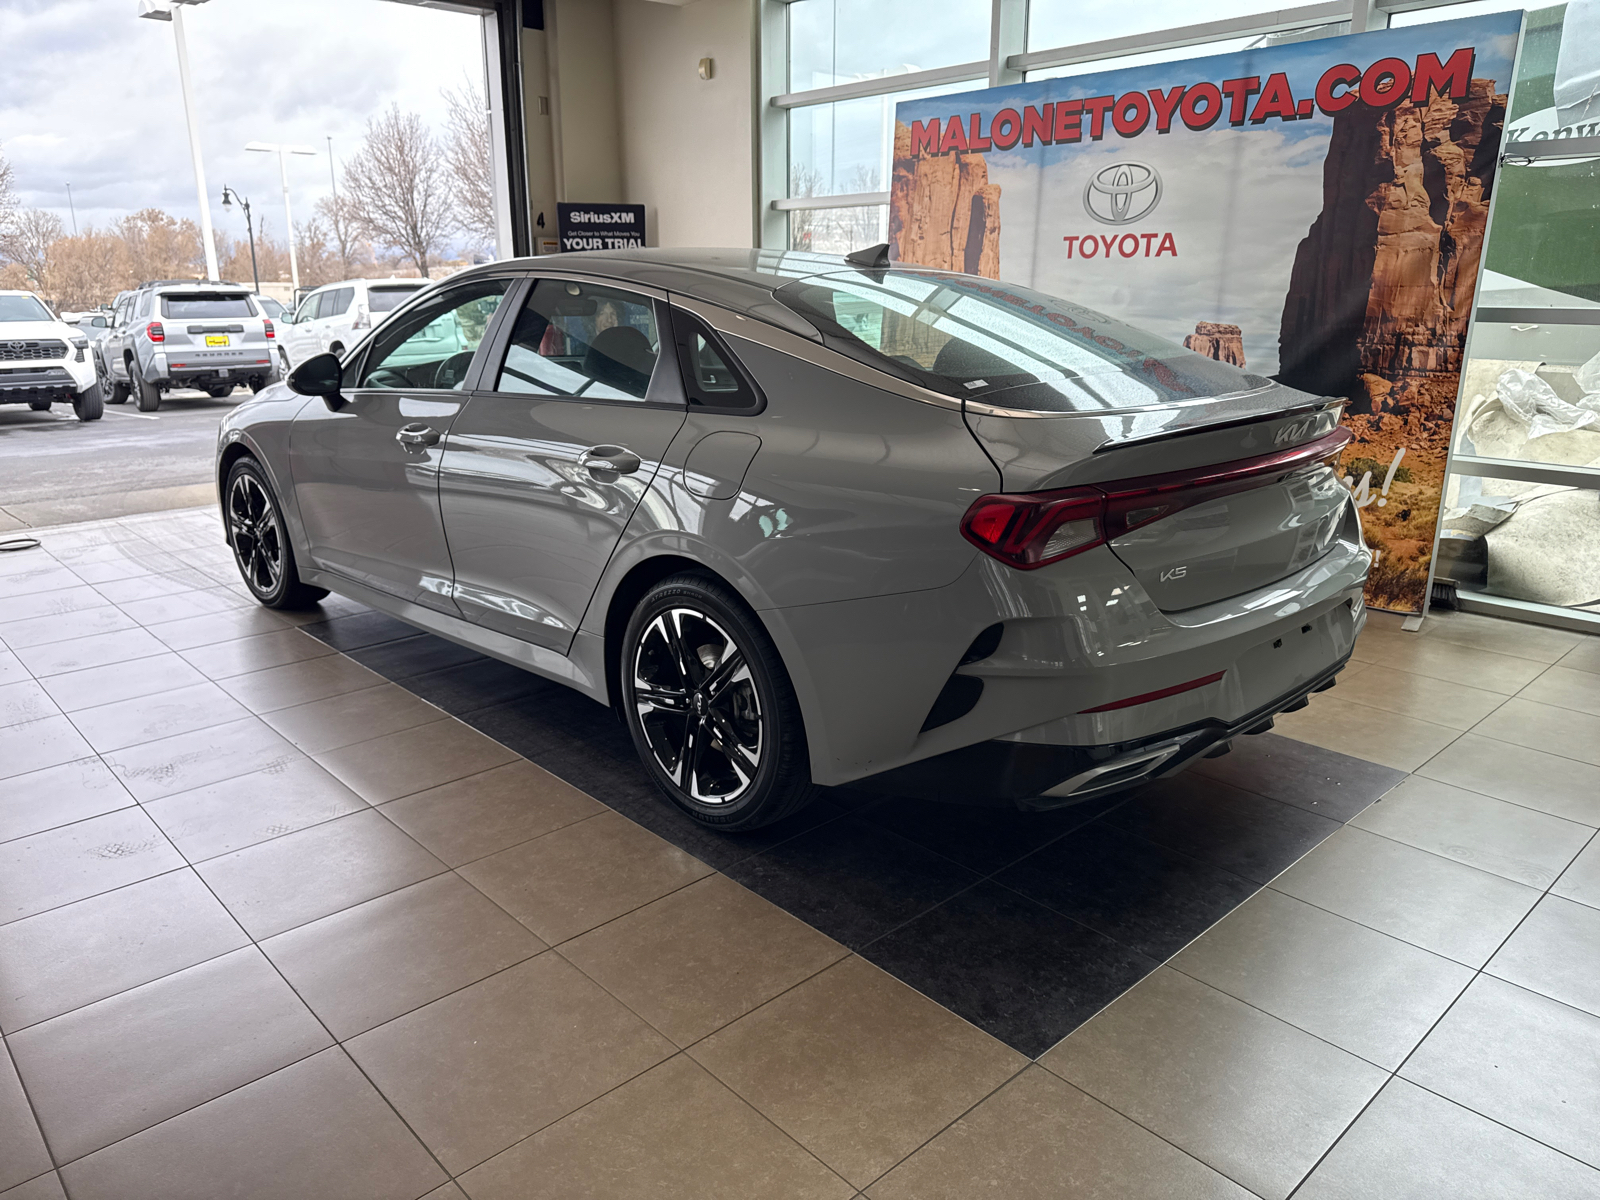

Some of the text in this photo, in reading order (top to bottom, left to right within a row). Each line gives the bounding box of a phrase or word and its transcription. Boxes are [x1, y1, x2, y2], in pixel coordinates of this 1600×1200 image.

[910, 47, 1476, 159] MALONETOYOTA.COM
[536, 212, 546, 229] 4
[570, 211, 635, 224] SiriusXM
[563, 238, 603, 250] YOUR
[605, 238, 646, 250] TRIAL
[1063, 232, 1178, 259] TOYOTA
[1160, 566, 1187, 582] K5
